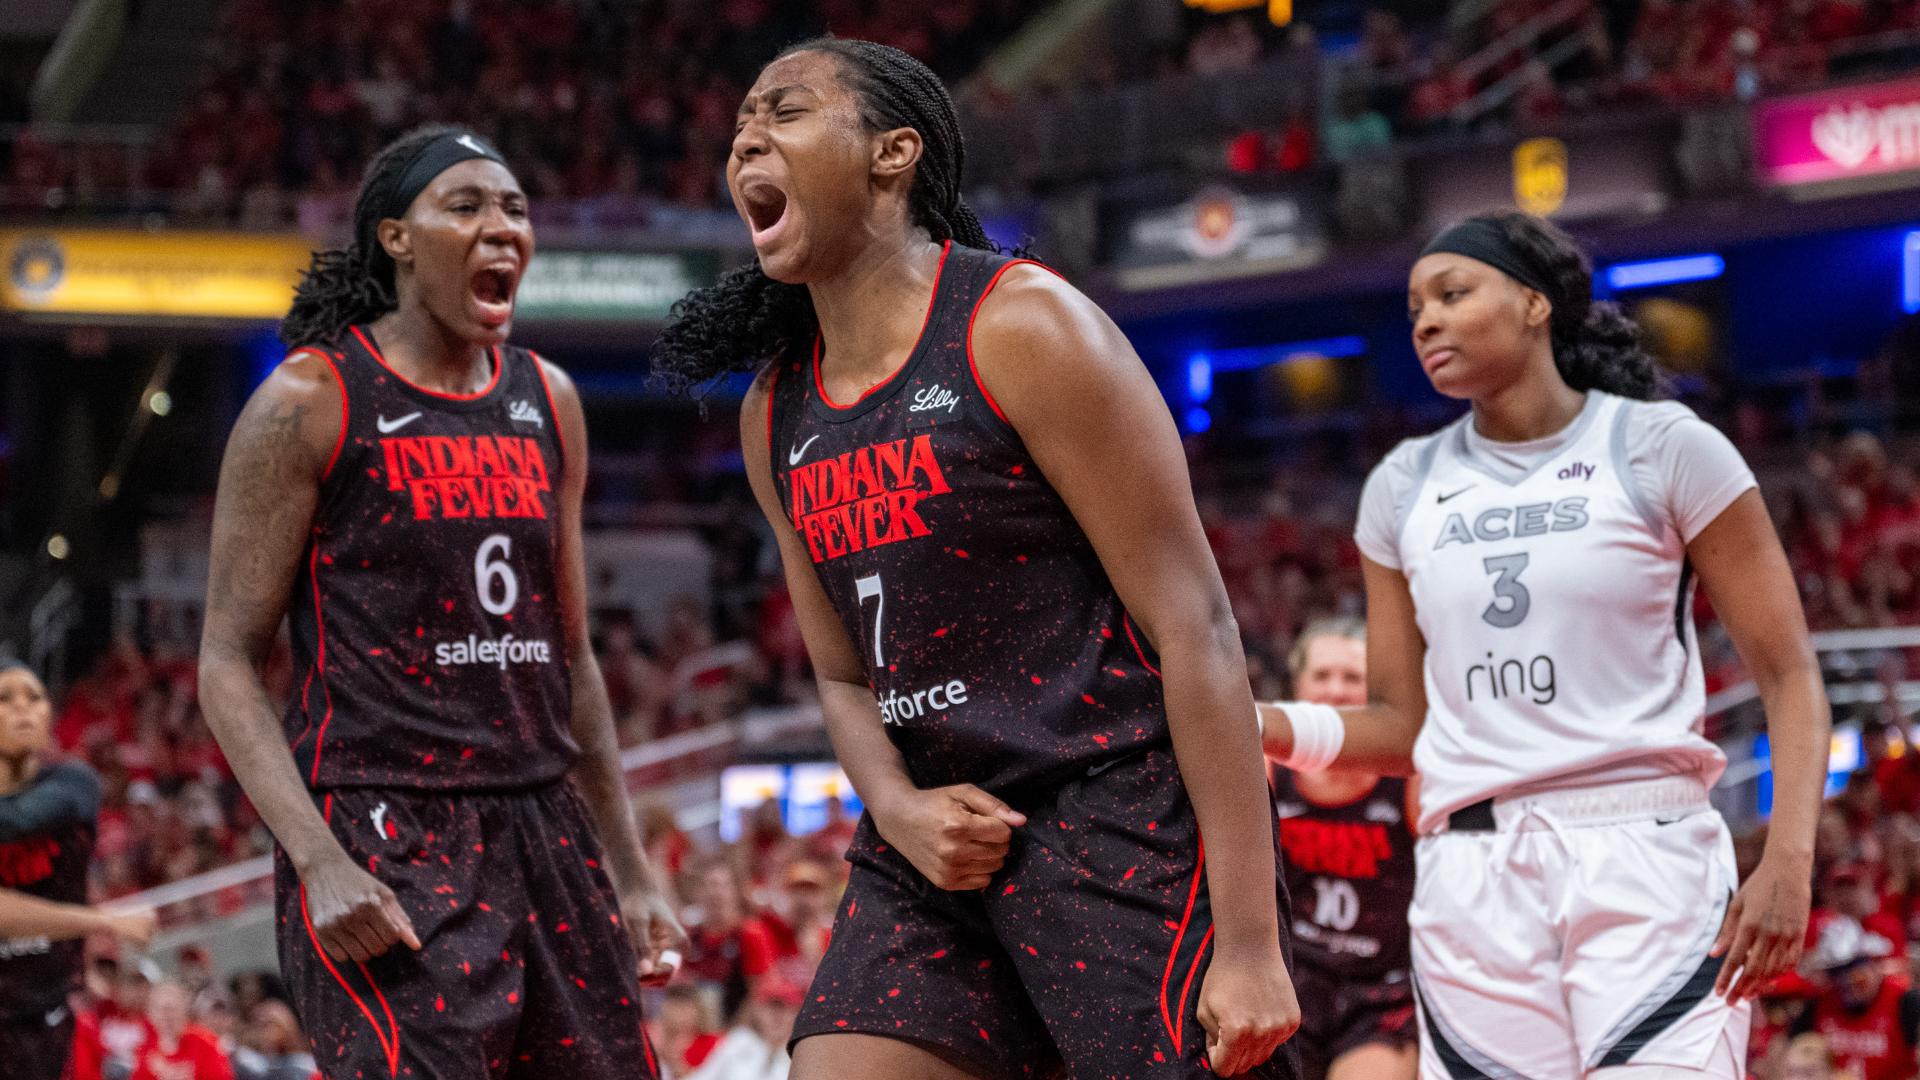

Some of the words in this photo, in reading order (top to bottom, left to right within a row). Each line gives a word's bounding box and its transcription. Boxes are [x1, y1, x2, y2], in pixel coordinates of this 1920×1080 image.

[909, 384, 960, 413] Lilly
[379, 434, 550, 492] INDIANA
[789, 434, 952, 532] INDIANA
[1557, 462, 1596, 482] ally
[407, 475, 547, 521] FEVER
[802, 489, 933, 563] FEVER
[1433, 496, 1590, 550] ACES
[474, 533, 519, 616] 6
[1482, 551, 1531, 629] 3
[855, 572, 885, 668] 7
[434, 633, 551, 672] salesforce
[1466, 651, 1556, 705] ring
